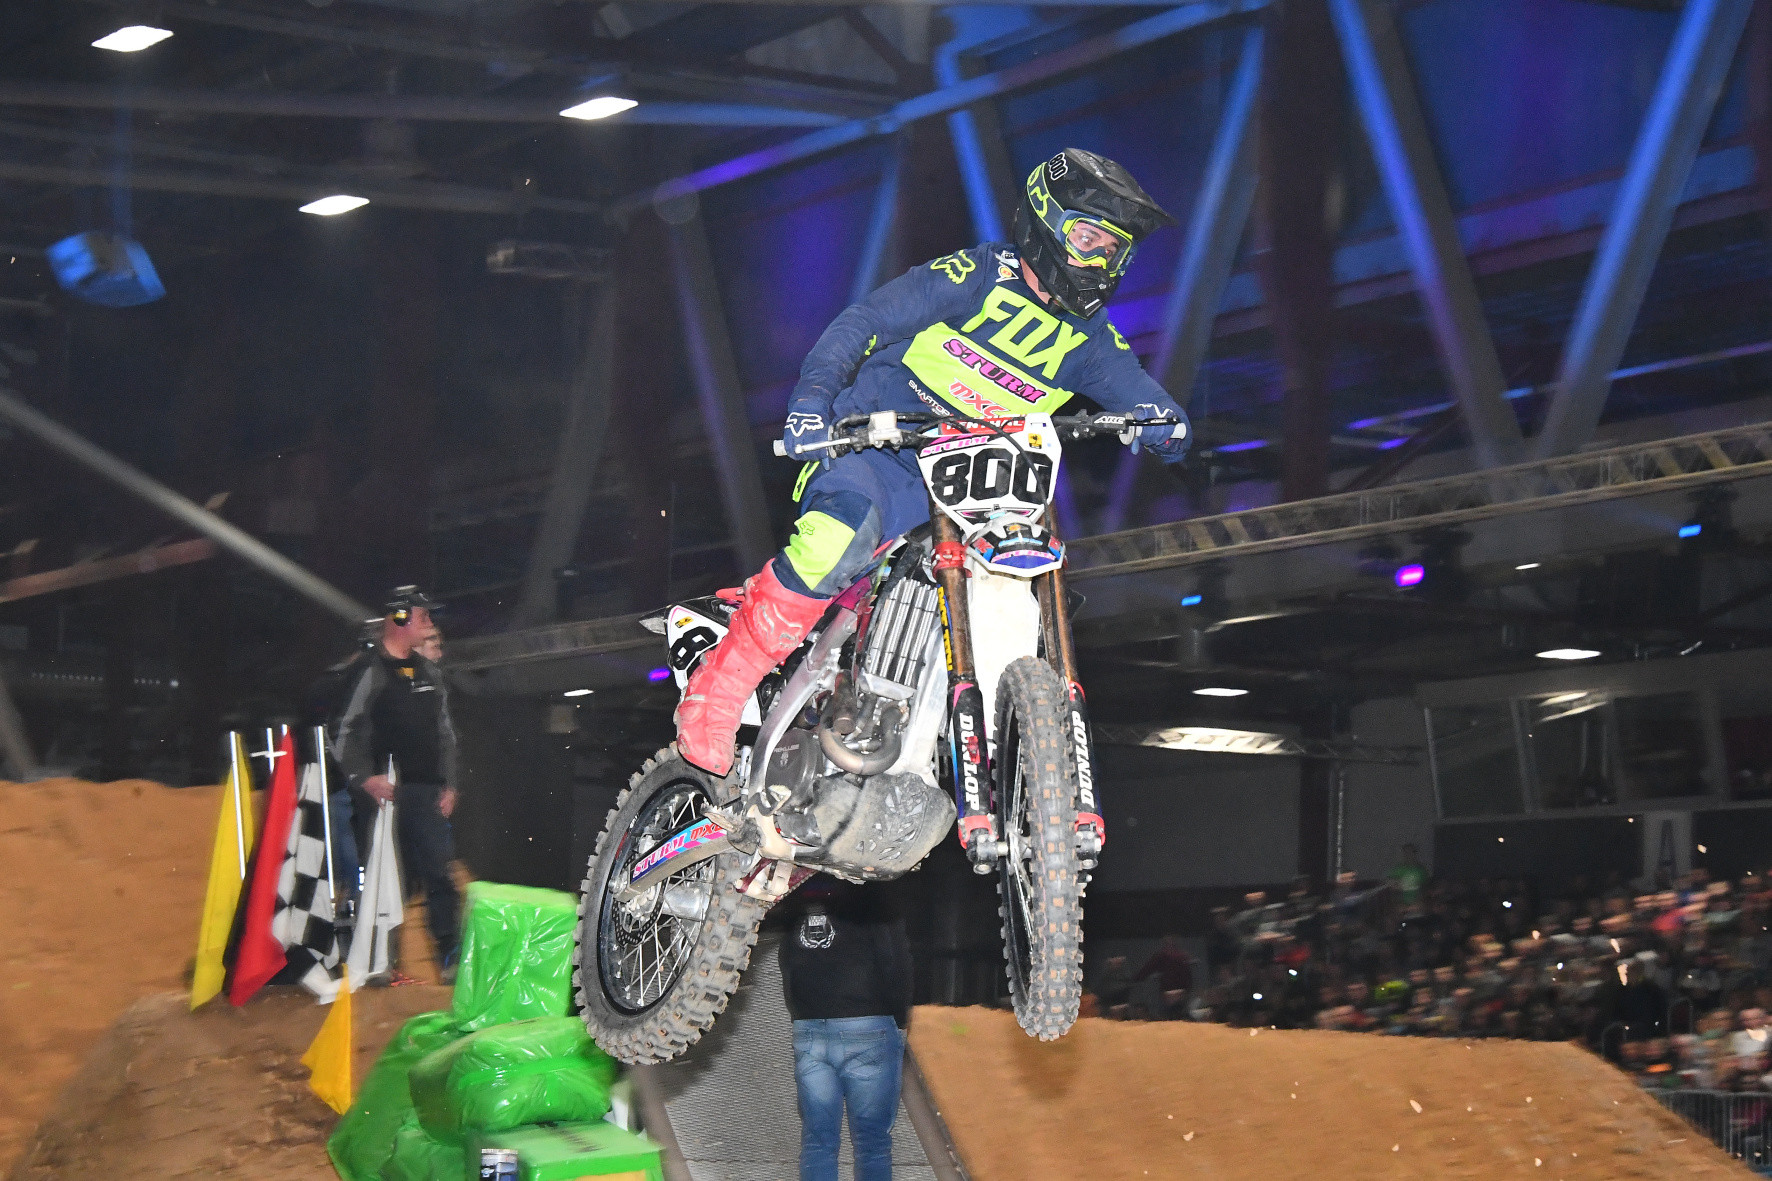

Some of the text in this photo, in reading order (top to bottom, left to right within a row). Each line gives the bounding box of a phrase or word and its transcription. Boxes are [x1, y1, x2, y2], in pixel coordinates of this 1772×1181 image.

[1049, 152, 1069, 181] 800
[961, 285, 1089, 381] FOX
[942, 338, 1047, 404] STURM
[1093, 415, 1126, 425] ARC
[931, 447, 1054, 507] 800
[1071, 710, 1095, 809] DUNLOP
[632, 833, 688, 878] STURM
